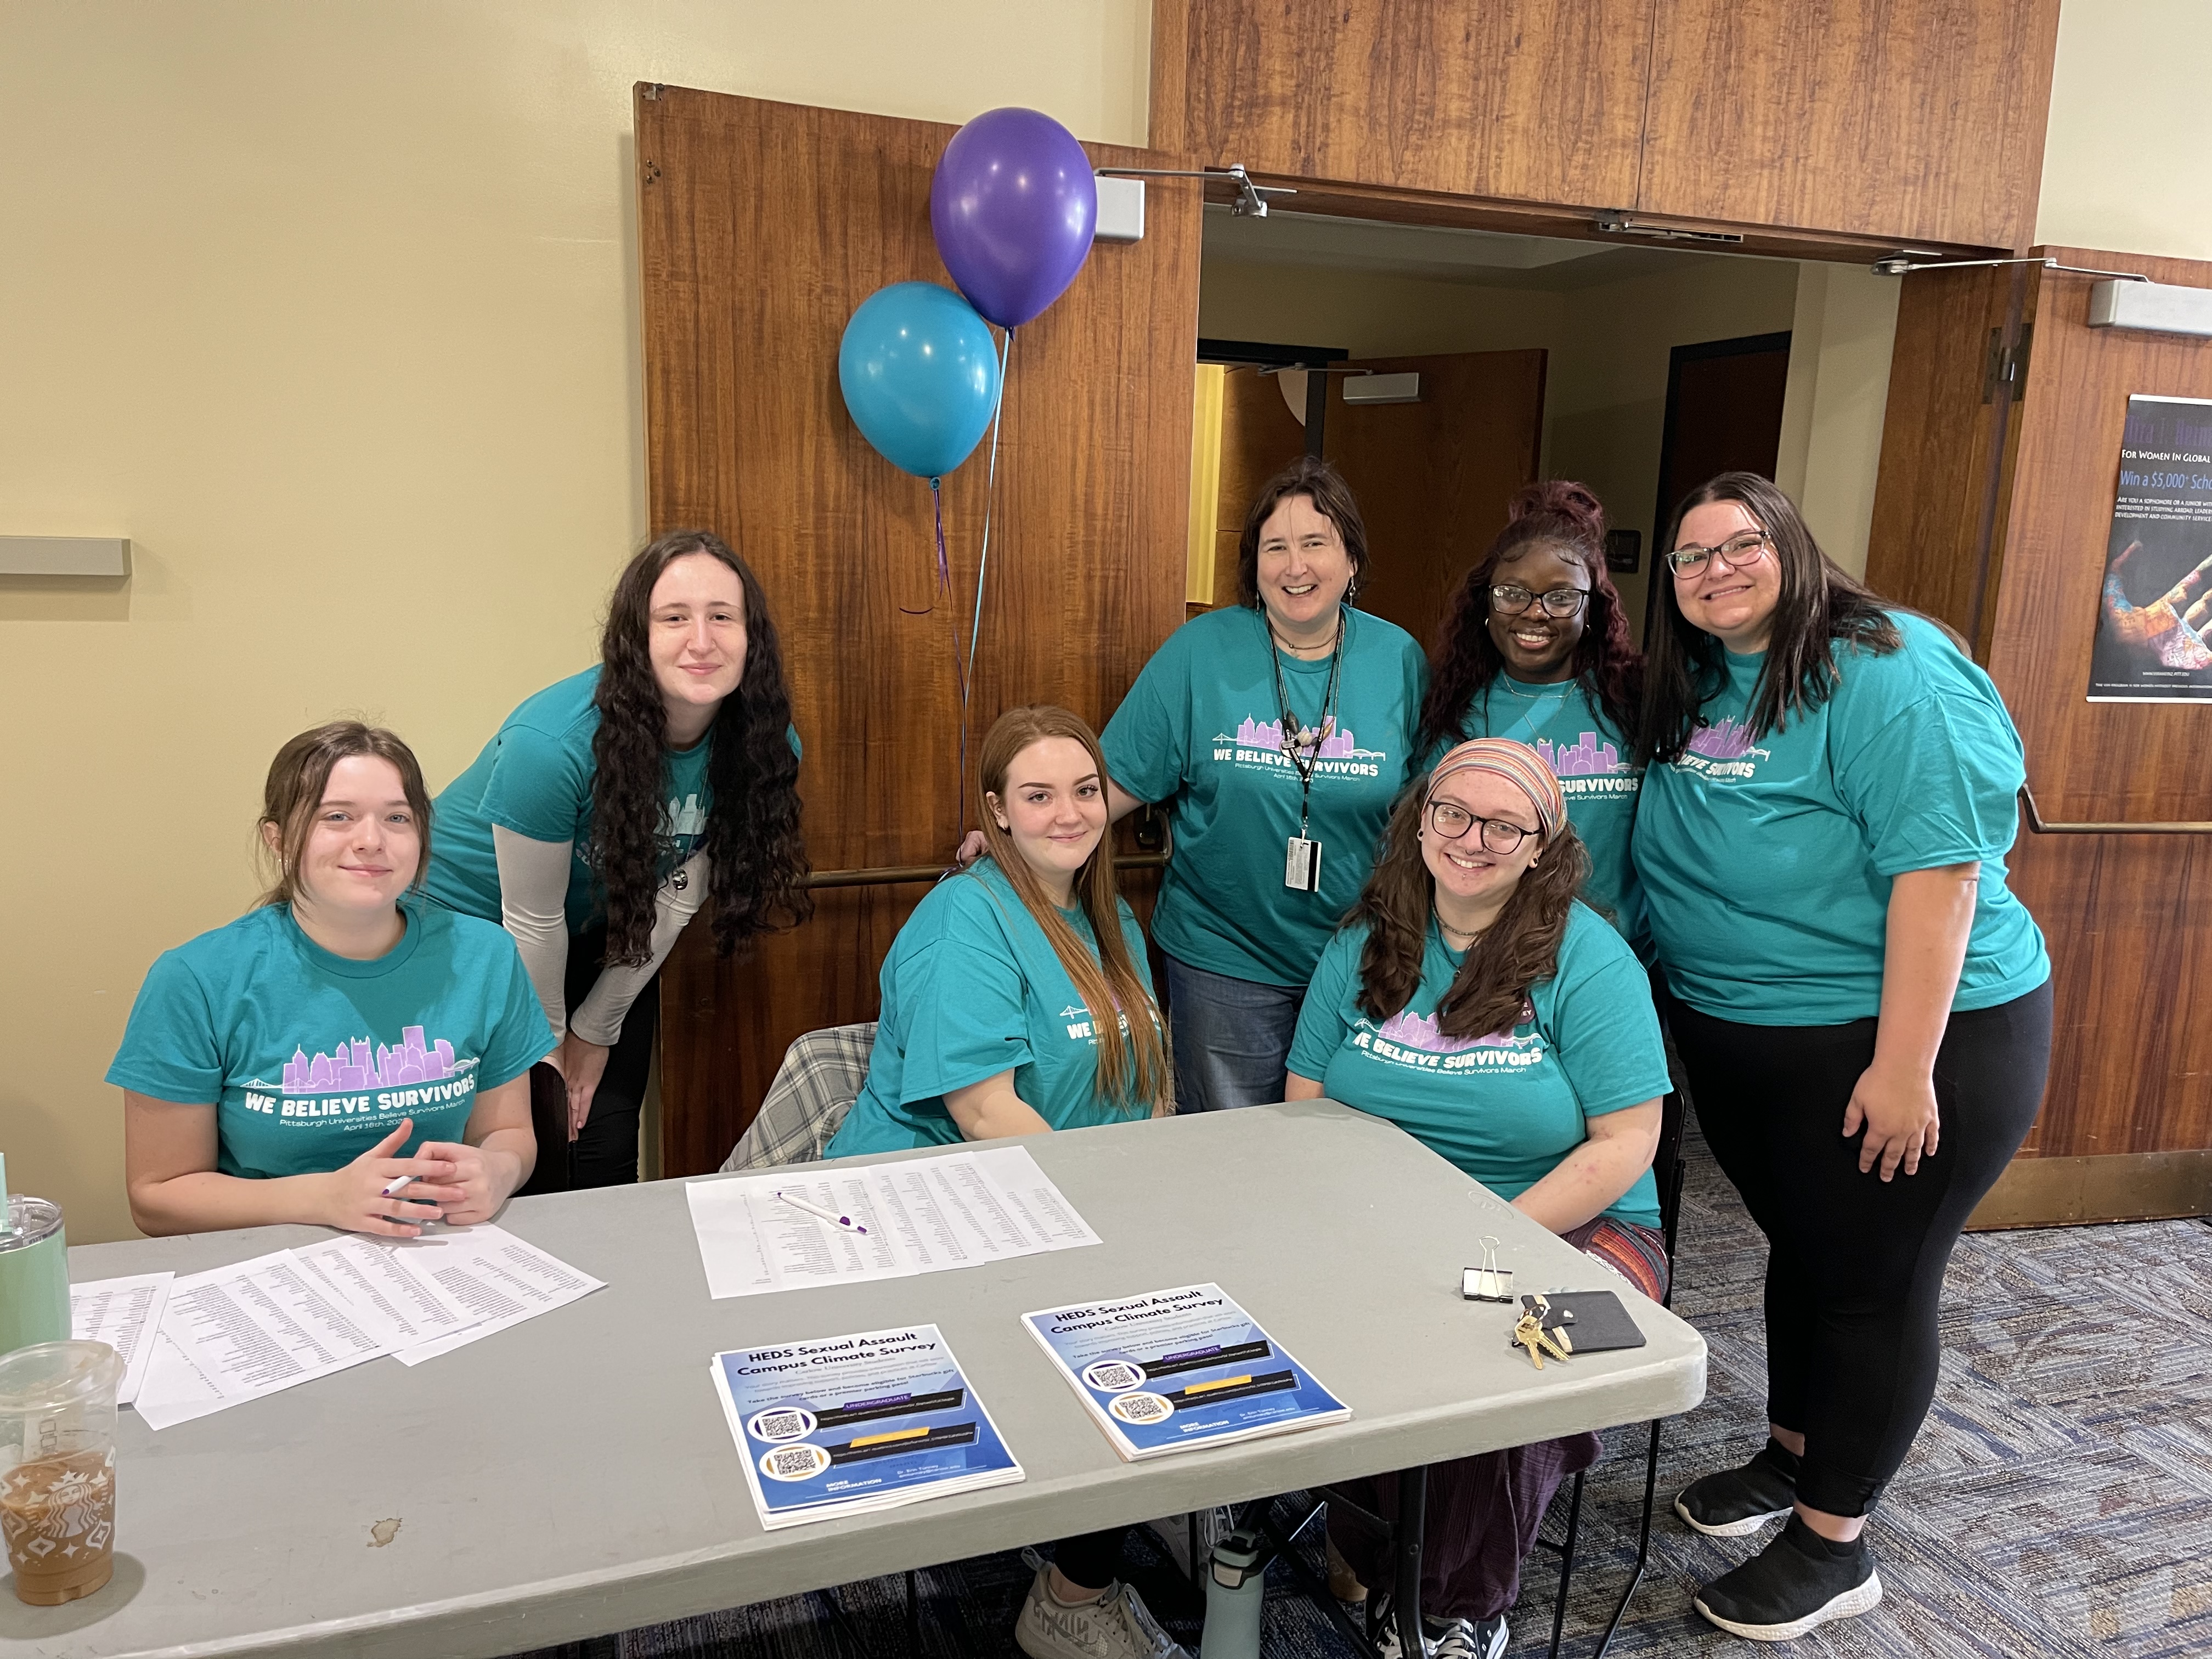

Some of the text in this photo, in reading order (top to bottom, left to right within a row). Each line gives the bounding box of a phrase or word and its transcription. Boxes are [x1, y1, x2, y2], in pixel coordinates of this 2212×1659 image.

[2121, 449, 2211, 464] FOR WOMEN IN GLOBAL
[2120, 470, 2140, 486] Win
[2142, 475, 2148, 486] a
[1214, 749, 1233, 760] WE
[1236, 749, 1291, 768] BELIEVE
[1265, 765, 1294, 775] Universities
[1558, 778, 1638, 793] SURVIVORS
[1066, 1022, 1091, 1039] WE
[1373, 1038, 1441, 1066] BELIEVE
[1443, 1047, 1542, 1068] SURVIVORS
[1361, 1050, 1394, 1064] Pittsburgh
[1395, 1062, 1435, 1073] Universities
[245, 1074, 475, 1116] WE BELIEVE SURVIVORS
[329, 1114, 377, 1124] Universities
[379, 1111, 407, 1120] Believe
[409, 1105, 444, 1115] Survivors
[446, 1099, 465, 1109] March
[344, 1123, 362, 1131] April
[1056, 1291, 1204, 1322] HEDS Sexual Assault
[1051, 1319, 1113, 1334] Campus
[1115, 1308, 1171, 1322] Climate
[1173, 1299, 1223, 1311] Survey
[749, 1333, 917, 1363] HEDS Sexual Assault
[1165, 1346, 1220, 1360] UNDERGRADUATE
[737, 1342, 936, 1375] Campus Climate Survey
[908, 1370, 942, 1379] Starbucks
[846, 1395, 909, 1408] UNDERGRADUATE
[1183, 1420, 1229, 1432] INFORMATION
[828, 1479, 882, 1492] INFORMATION
